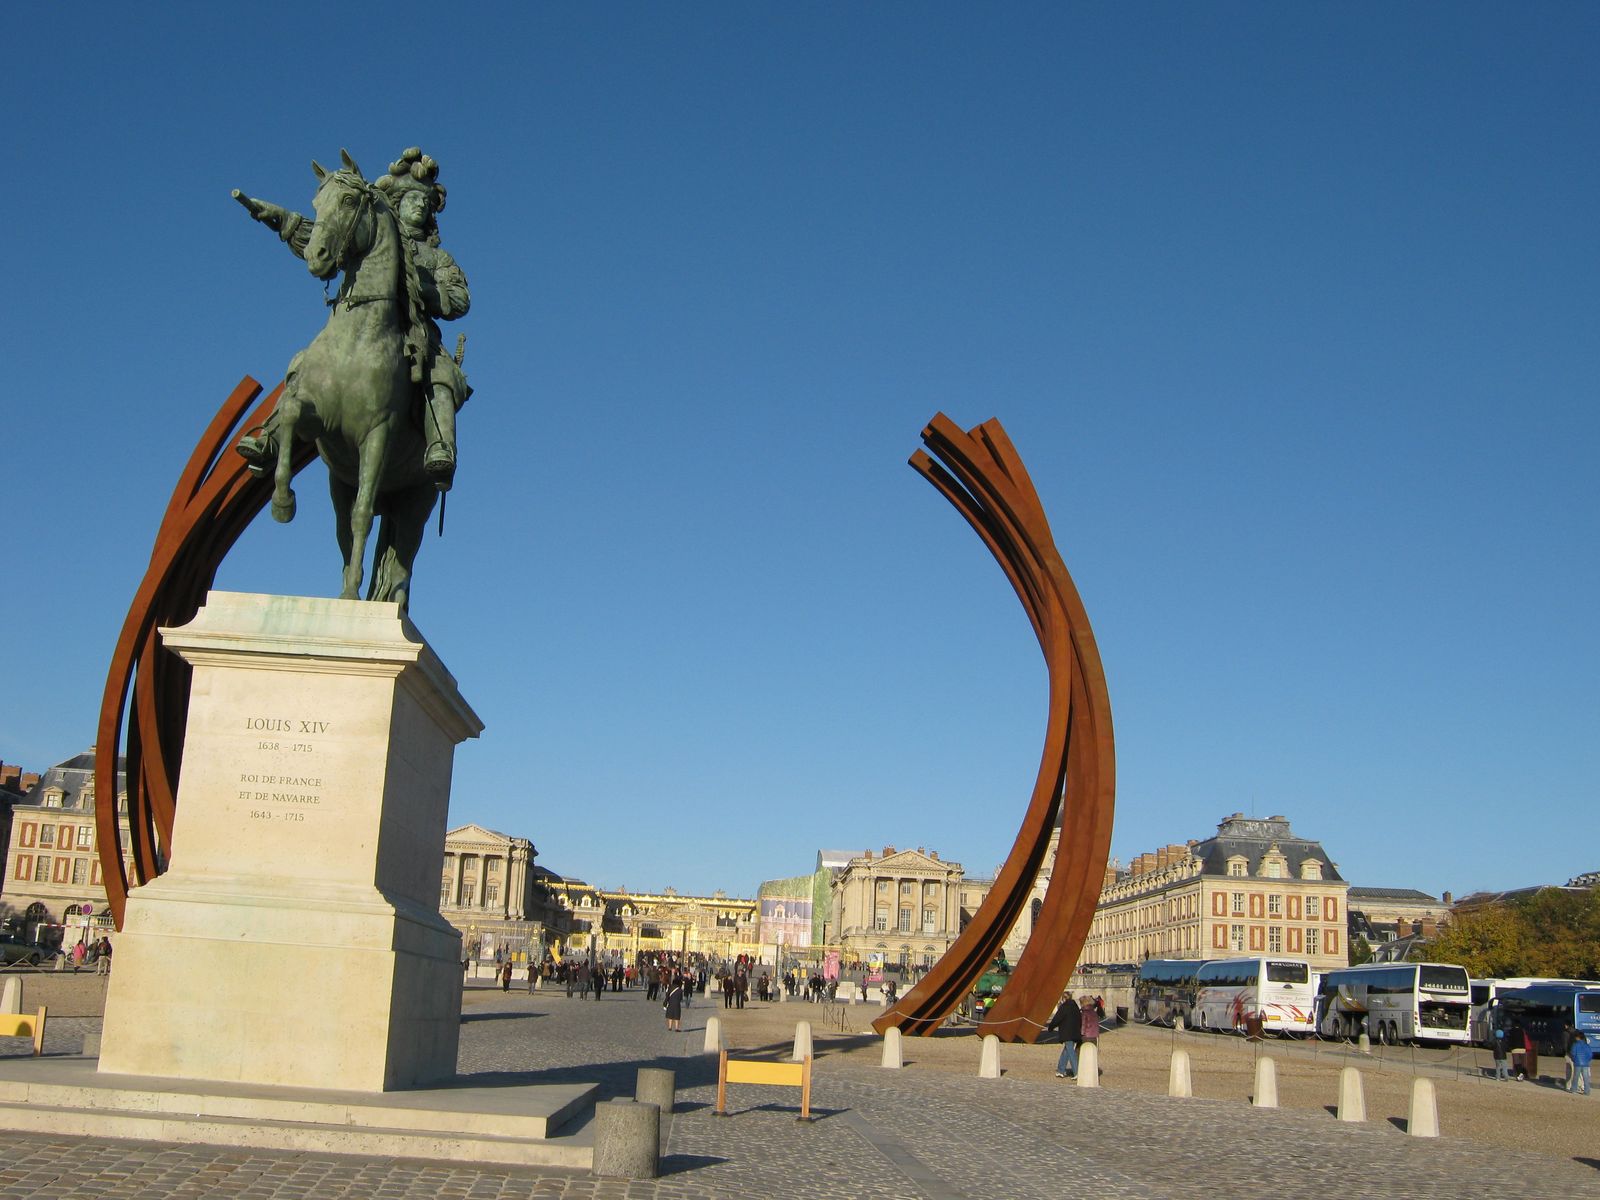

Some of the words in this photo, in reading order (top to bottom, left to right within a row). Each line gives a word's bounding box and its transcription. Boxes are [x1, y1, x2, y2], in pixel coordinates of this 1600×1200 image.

[246, 717, 292, 732] LOUIS
[299, 720, 330, 734] XIV
[257, 741, 280, 751] 1638
[292, 743, 313, 752] 1715
[240, 774, 259, 783] ROI
[261, 775, 277, 784] DE
[279, 776, 322, 787] FRANCE
[239, 791, 252, 800] ET
[255, 792, 269, 801] DE
[272, 793, 321, 804] NAVARRE
[250, 810, 272, 820] 1643
[285, 812, 305, 822] 1715
